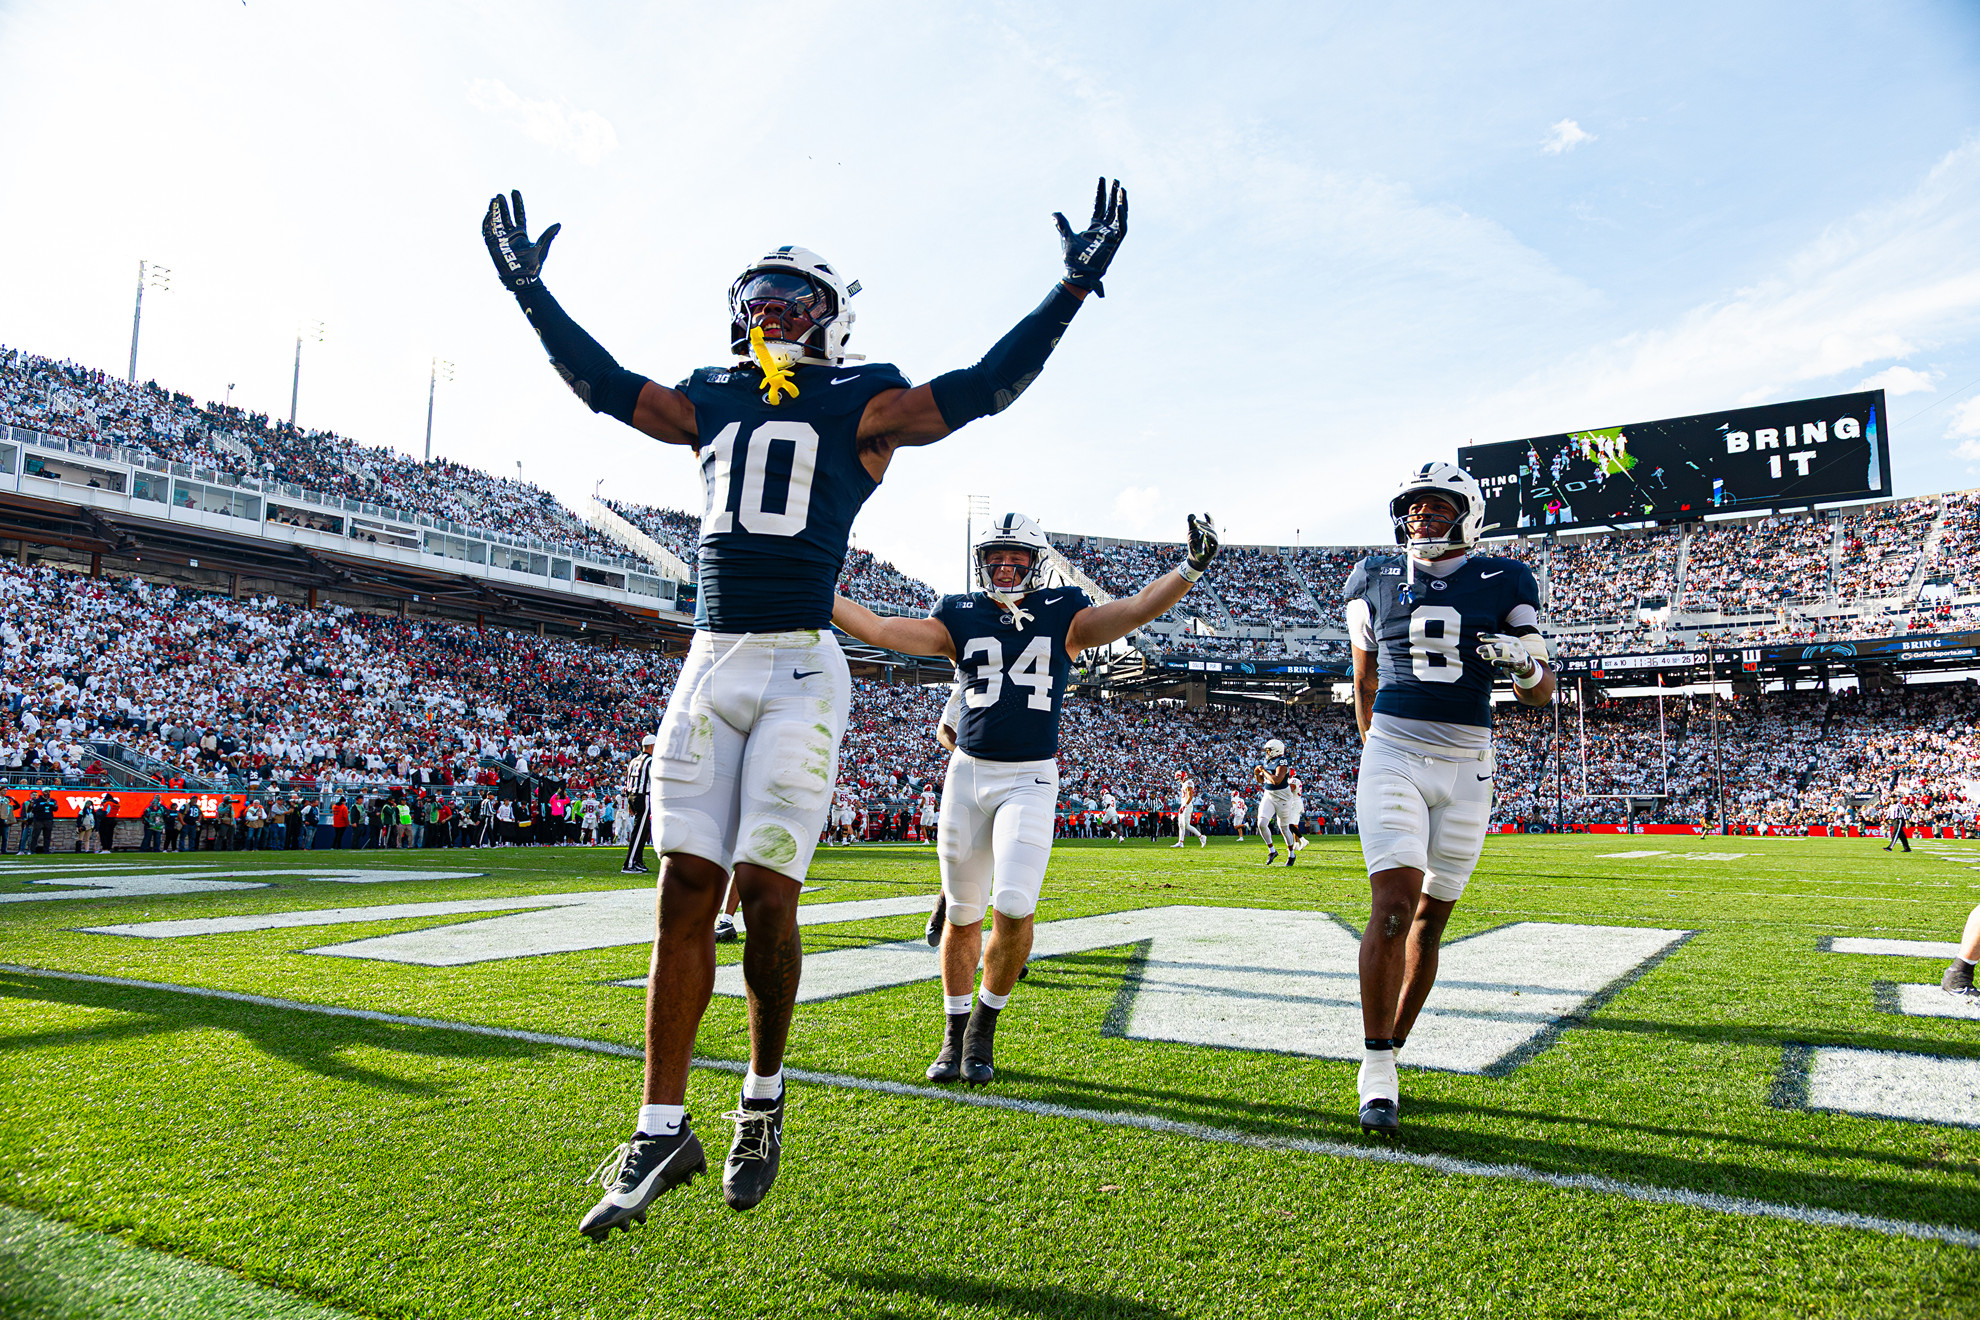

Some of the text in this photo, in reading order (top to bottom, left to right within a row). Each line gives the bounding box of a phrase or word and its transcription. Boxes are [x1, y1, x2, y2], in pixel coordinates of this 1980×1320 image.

[1078, 226, 1111, 265] STATE
[498, 237, 521, 271] PENN
[1726, 417, 1861, 454] BRING
[1769, 450, 1817, 479] IT
[700, 421, 820, 537] 10
[1485, 486, 1503, 499] IT
[1409, 605, 1463, 683] 8
[1902, 639, 1942, 650] BRING
[1694, 653, 1708, 664] 20
[1913, 649, 1973, 659] GoPSUsports.com
[1590, 660, 1599, 669] 17
[1634, 657, 1659, 667] 11:36
[1682, 656, 1691, 664] 25
[1743, 662, 1757, 672] 40
[962, 636, 1054, 712] 34
[1591, 670, 1604, 679] 40
[189, 807, 199, 817] 18
[585, 804, 594, 813] 18
[1616, 824, 1644, 833] wis
